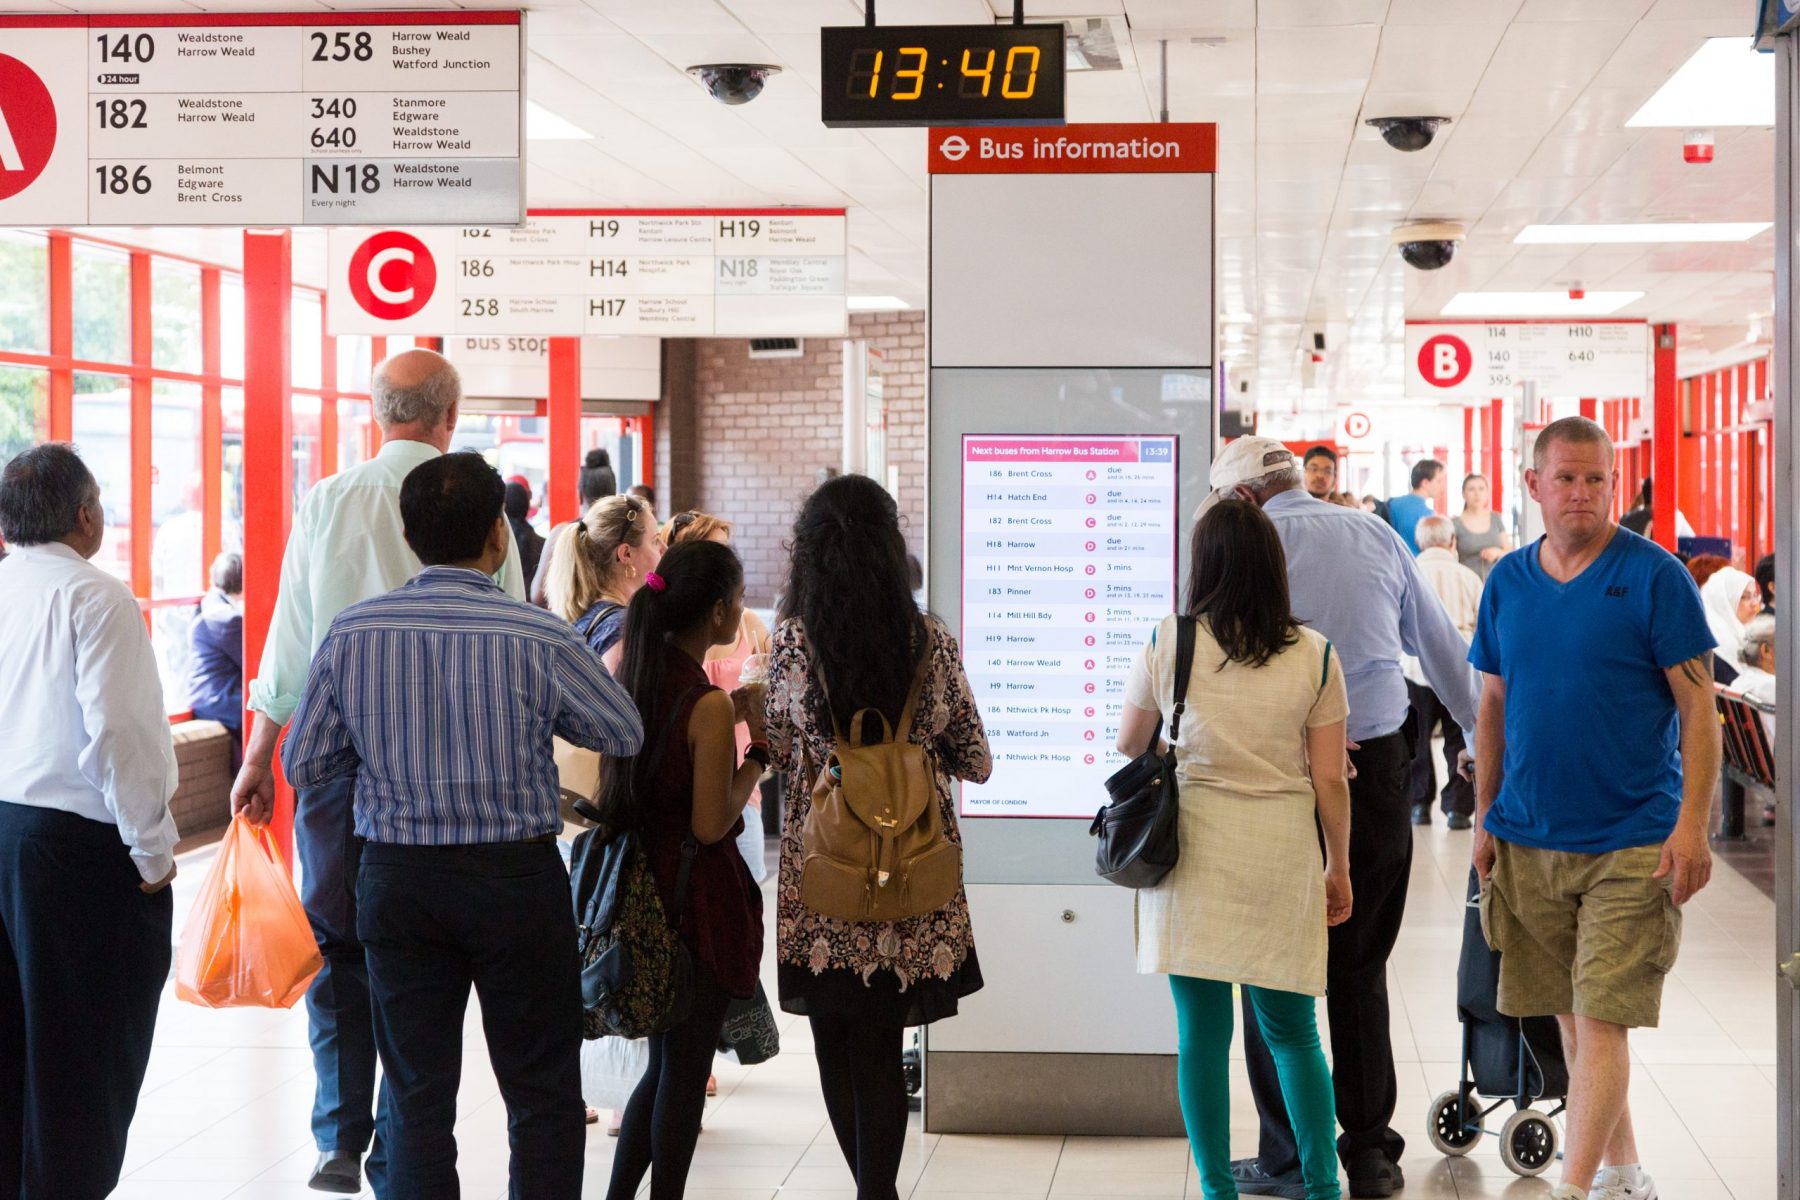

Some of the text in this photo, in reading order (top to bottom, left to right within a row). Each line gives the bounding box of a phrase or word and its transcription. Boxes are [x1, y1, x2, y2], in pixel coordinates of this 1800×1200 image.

[178, 33, 243, 42] Wealdstone
[392, 31, 470, 41] Harrow Weald
[97, 33, 155, 63] 140
[178, 47, 255, 56] Harrow Weald
[310, 31, 373, 62] 258
[392, 46, 431, 56] Bushey
[393, 59, 491, 69] Watford Junction
[868, 45, 1041, 100] 13:40
[106, 75, 138, 83] 24 hour
[178, 99, 243, 108] Wealdstone
[393, 98, 446, 107] Stanmore
[311, 97, 357, 119] 340
[96, 99, 147, 128] 182
[178, 112, 255, 122] Harrow Weald
[393, 111, 439, 122] Edgware
[393, 127, 459, 136] Wealdstone
[311, 127, 356, 148] 640
[393, 140, 471, 149] Harrow Weald
[979, 137, 1180, 159] Bus information
[178, 165, 224, 174] Belmont
[394, 164, 459, 173] Wealdstone
[96, 165, 152, 194] 186
[312, 163, 380, 194] N18
[394, 178, 472, 187] Harrow Weald
[178, 179, 224, 190] Edgware
[178, 193, 243, 202] Brent Cross
[312, 199, 356, 208] Every night
[590, 220, 619, 237] H9
[720, 220, 760, 238] H19
[461, 260, 494, 277] 186
[590, 260, 627, 277] H14
[720, 259, 758, 277] N18
[366, 247, 414, 304] C
[461, 299, 499, 316] 258
[590, 299, 626, 316] H17
[1488, 327, 1506, 337] 114
[1569, 326, 1593, 337] H10
[1433, 343, 1459, 379] B
[1488, 351, 1510, 361] 140
[1569, 351, 1594, 361] 640
[1488, 374, 1512, 386] 395
[972, 446, 1120, 456] Next buses from Harrow Bus Station
[1145, 447, 1168, 456] 13:39
[1054, 565, 1074, 573] Hosp
[1605, 585, 1629, 598] A&F
[1038, 612, 1052, 620] Bdy
[1052, 706, 1071, 714] Hosp
[1052, 754, 1071, 762] Hosp
